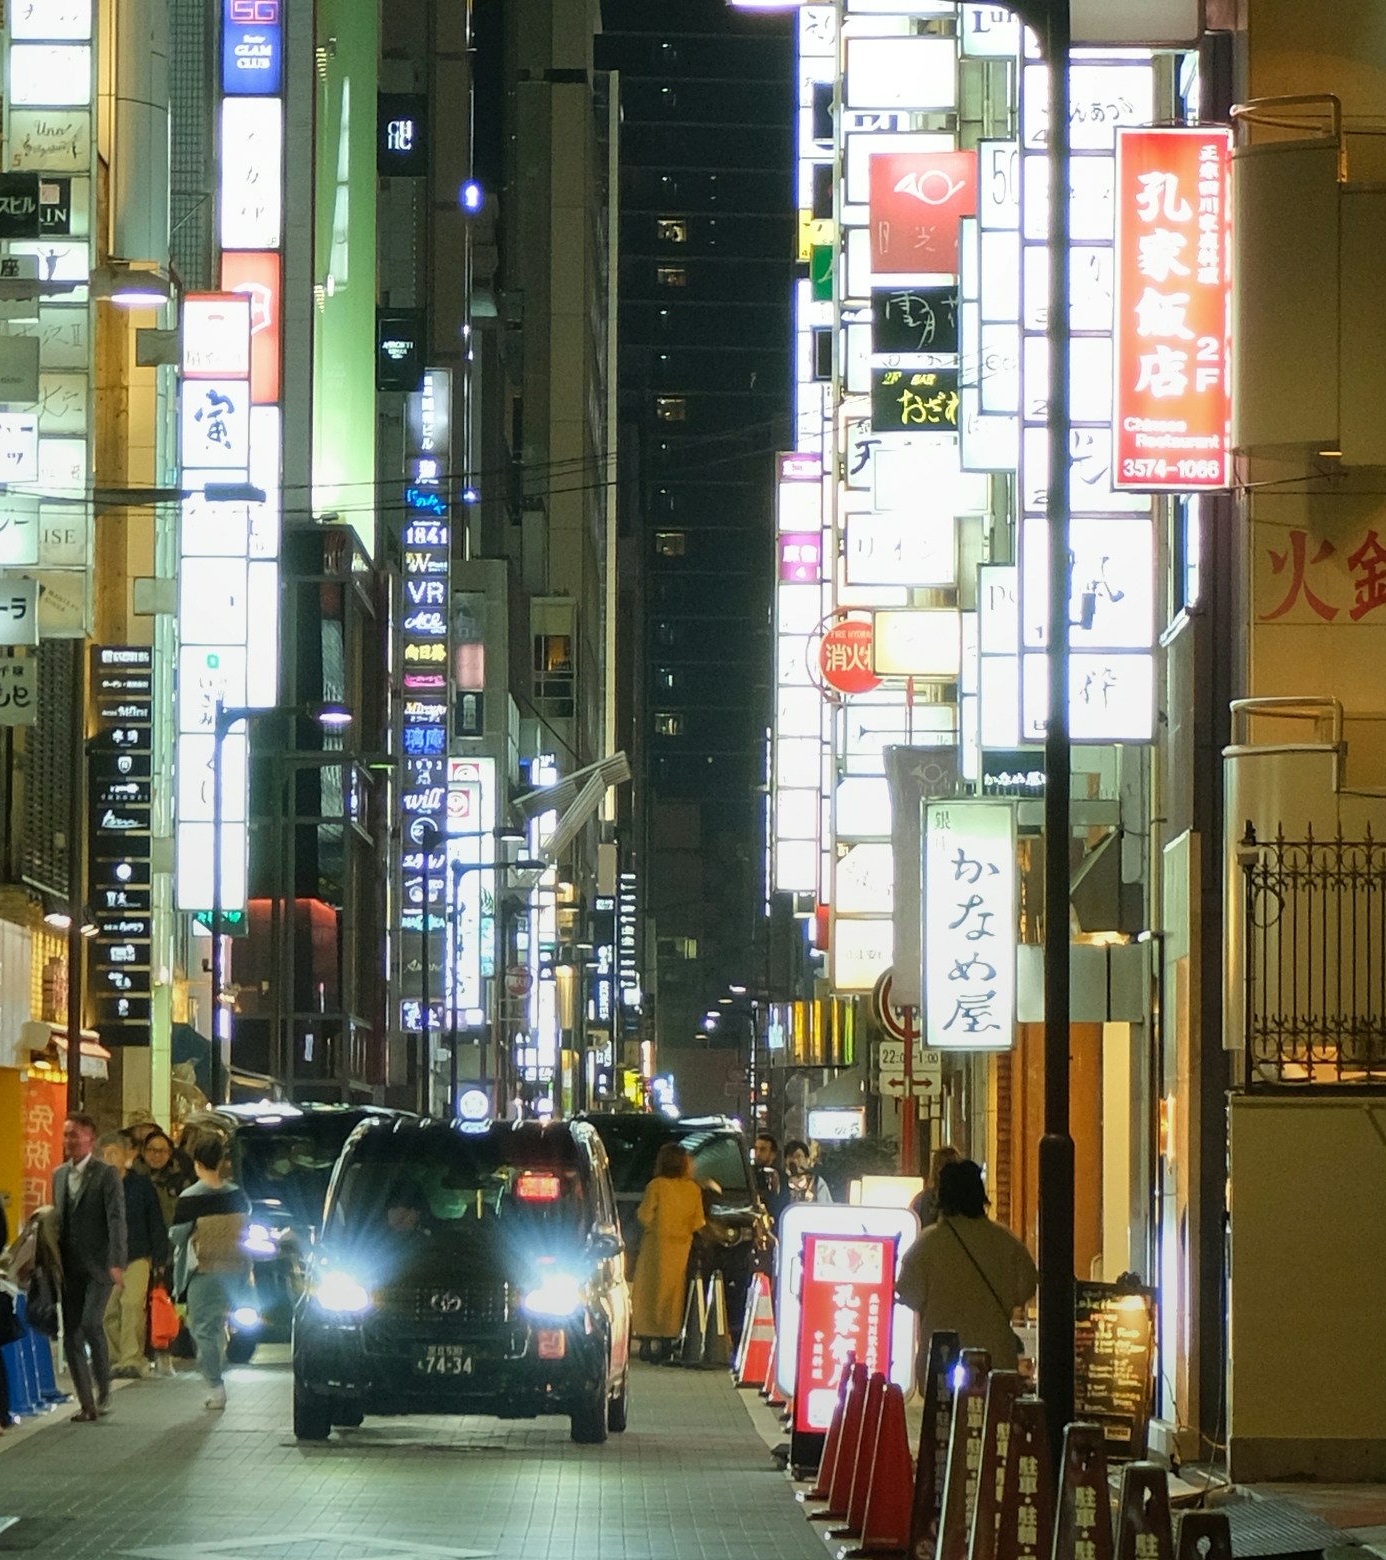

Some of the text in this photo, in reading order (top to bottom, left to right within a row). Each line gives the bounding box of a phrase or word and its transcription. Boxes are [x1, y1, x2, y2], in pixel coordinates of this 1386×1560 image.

[234, 44, 272, 56] GLAM
[236, 57, 271, 69] CLUB
[1133, 170, 1197, 401] 孔家飯店
[1196, 337, 1219, 394] 2F
[194, 388, 235, 450] 寅
[1123, 458, 1220, 480] 3574-1066
[406, 526, 448, 545] 1841
[407, 581, 445, 605] VR
[403, 786, 446, 810] will
[942, 847, 1001, 1034] かなめ屋
